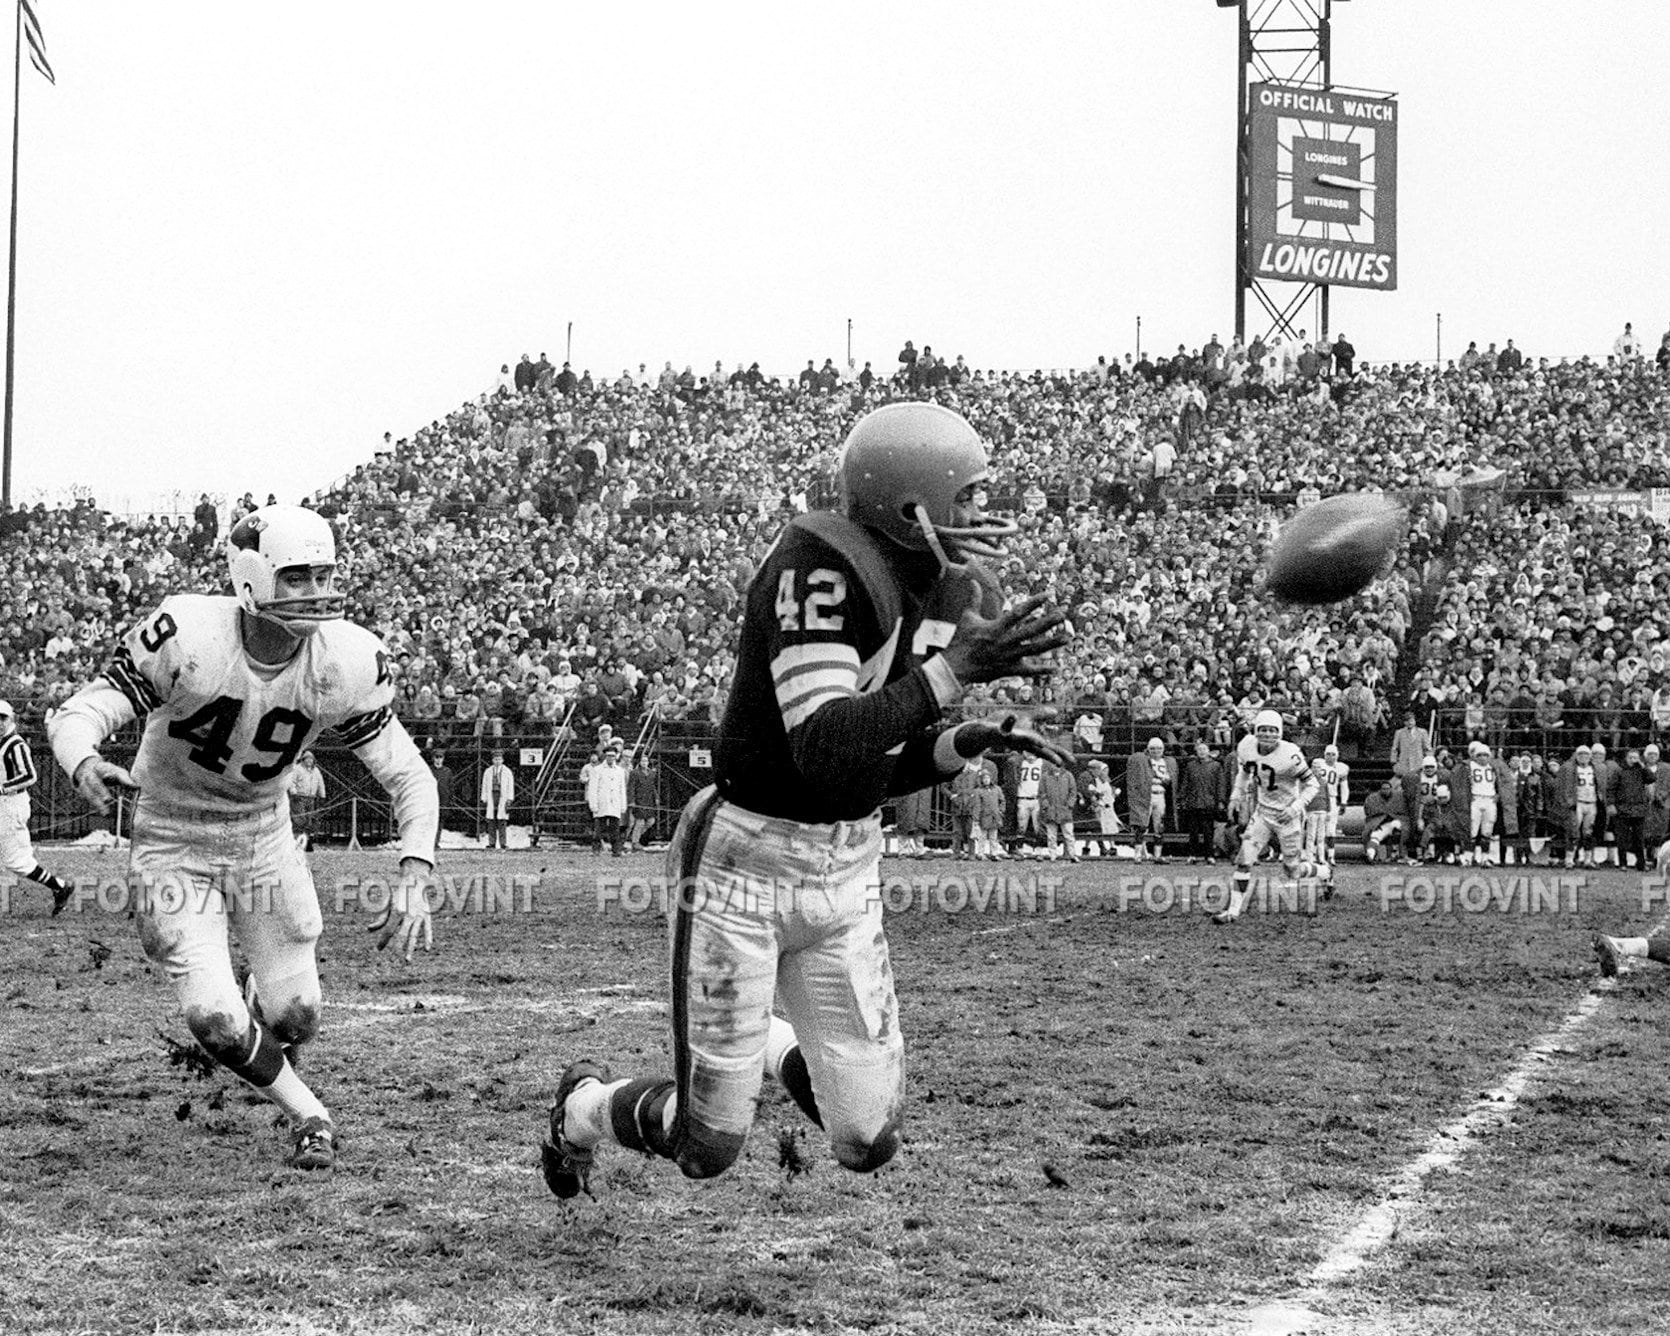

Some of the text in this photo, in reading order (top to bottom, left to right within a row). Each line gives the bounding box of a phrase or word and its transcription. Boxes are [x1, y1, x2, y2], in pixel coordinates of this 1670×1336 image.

[1260, 90, 1393, 120] OFFICIAL WATCH
[1305, 152, 1348, 166] LONGINES
[1259, 243, 1391, 283] LONGINES
[775, 568, 847, 631] 42
[169, 695, 313, 783] 49
[527, 754, 536, 763] 3
[697, 756, 706, 765] 5
[1020, 767, 1040, 781] 76
[1473, 768, 1494, 783] 60
